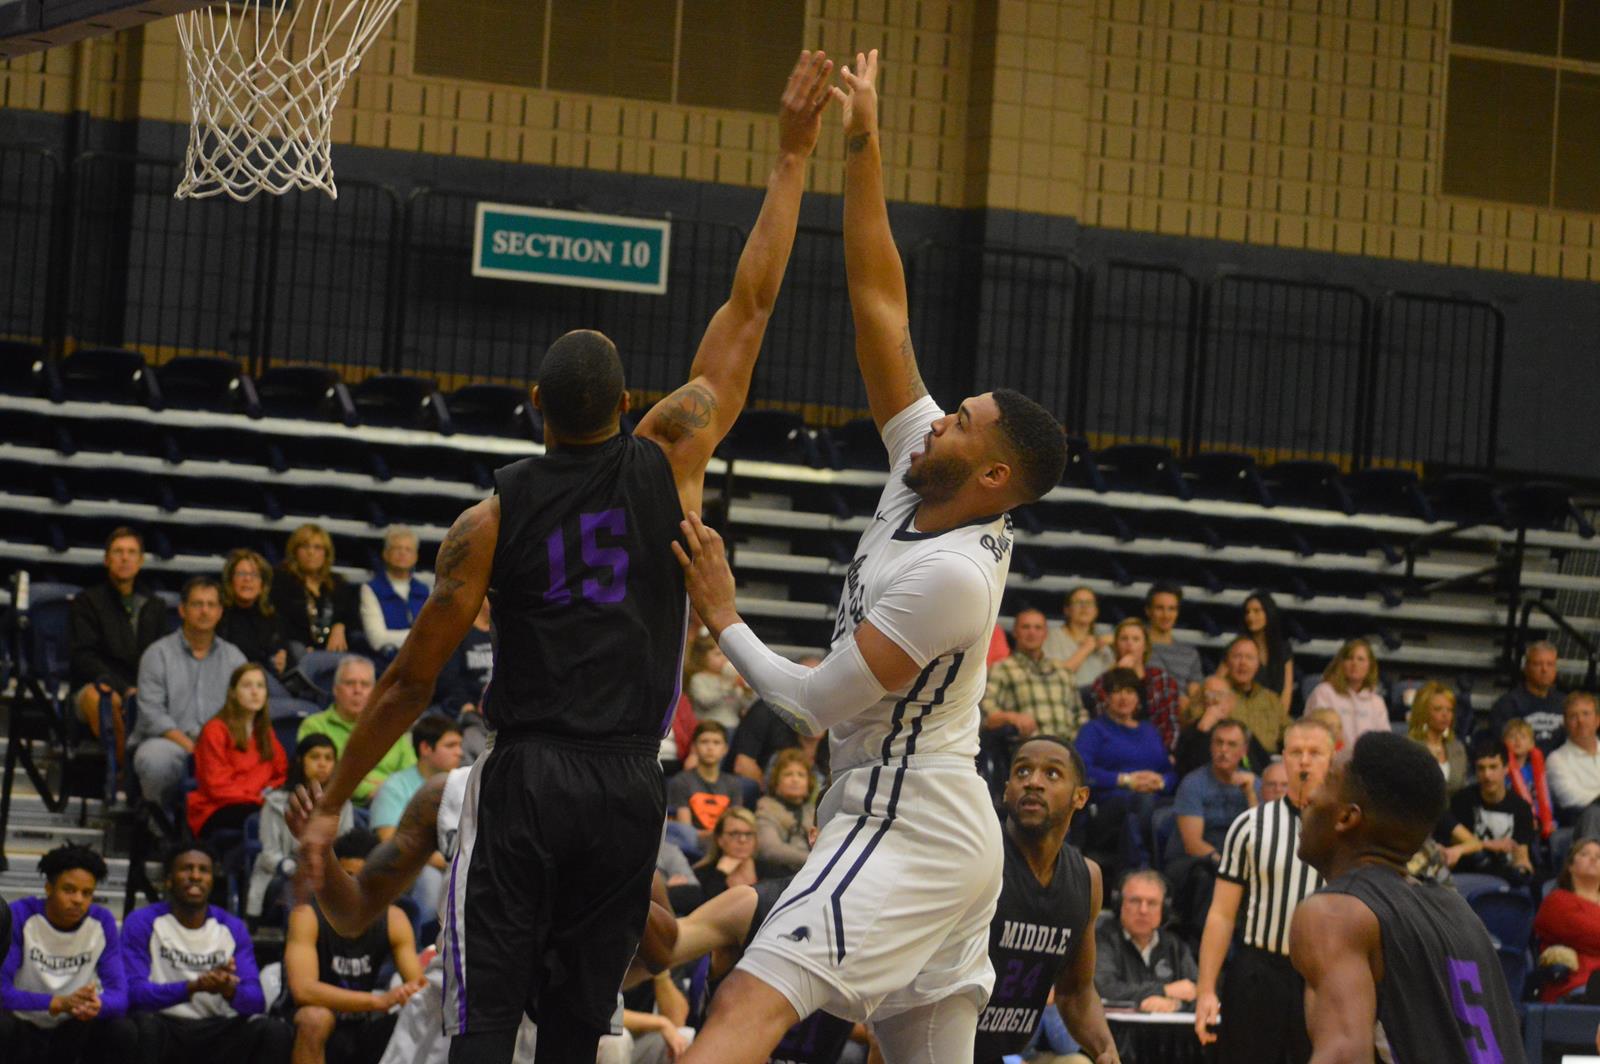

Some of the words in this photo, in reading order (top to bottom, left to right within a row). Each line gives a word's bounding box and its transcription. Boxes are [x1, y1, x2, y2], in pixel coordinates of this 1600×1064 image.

[492, 229, 614, 265] SECTION
[620, 240, 651, 269] 10
[543, 508, 630, 605] 15
[998, 920, 1072, 955] MIDDLE
[999, 959, 1043, 1001] 24
[977, 1006, 1038, 1034] EORGIA
[1446, 955, 1505, 1064] 5
